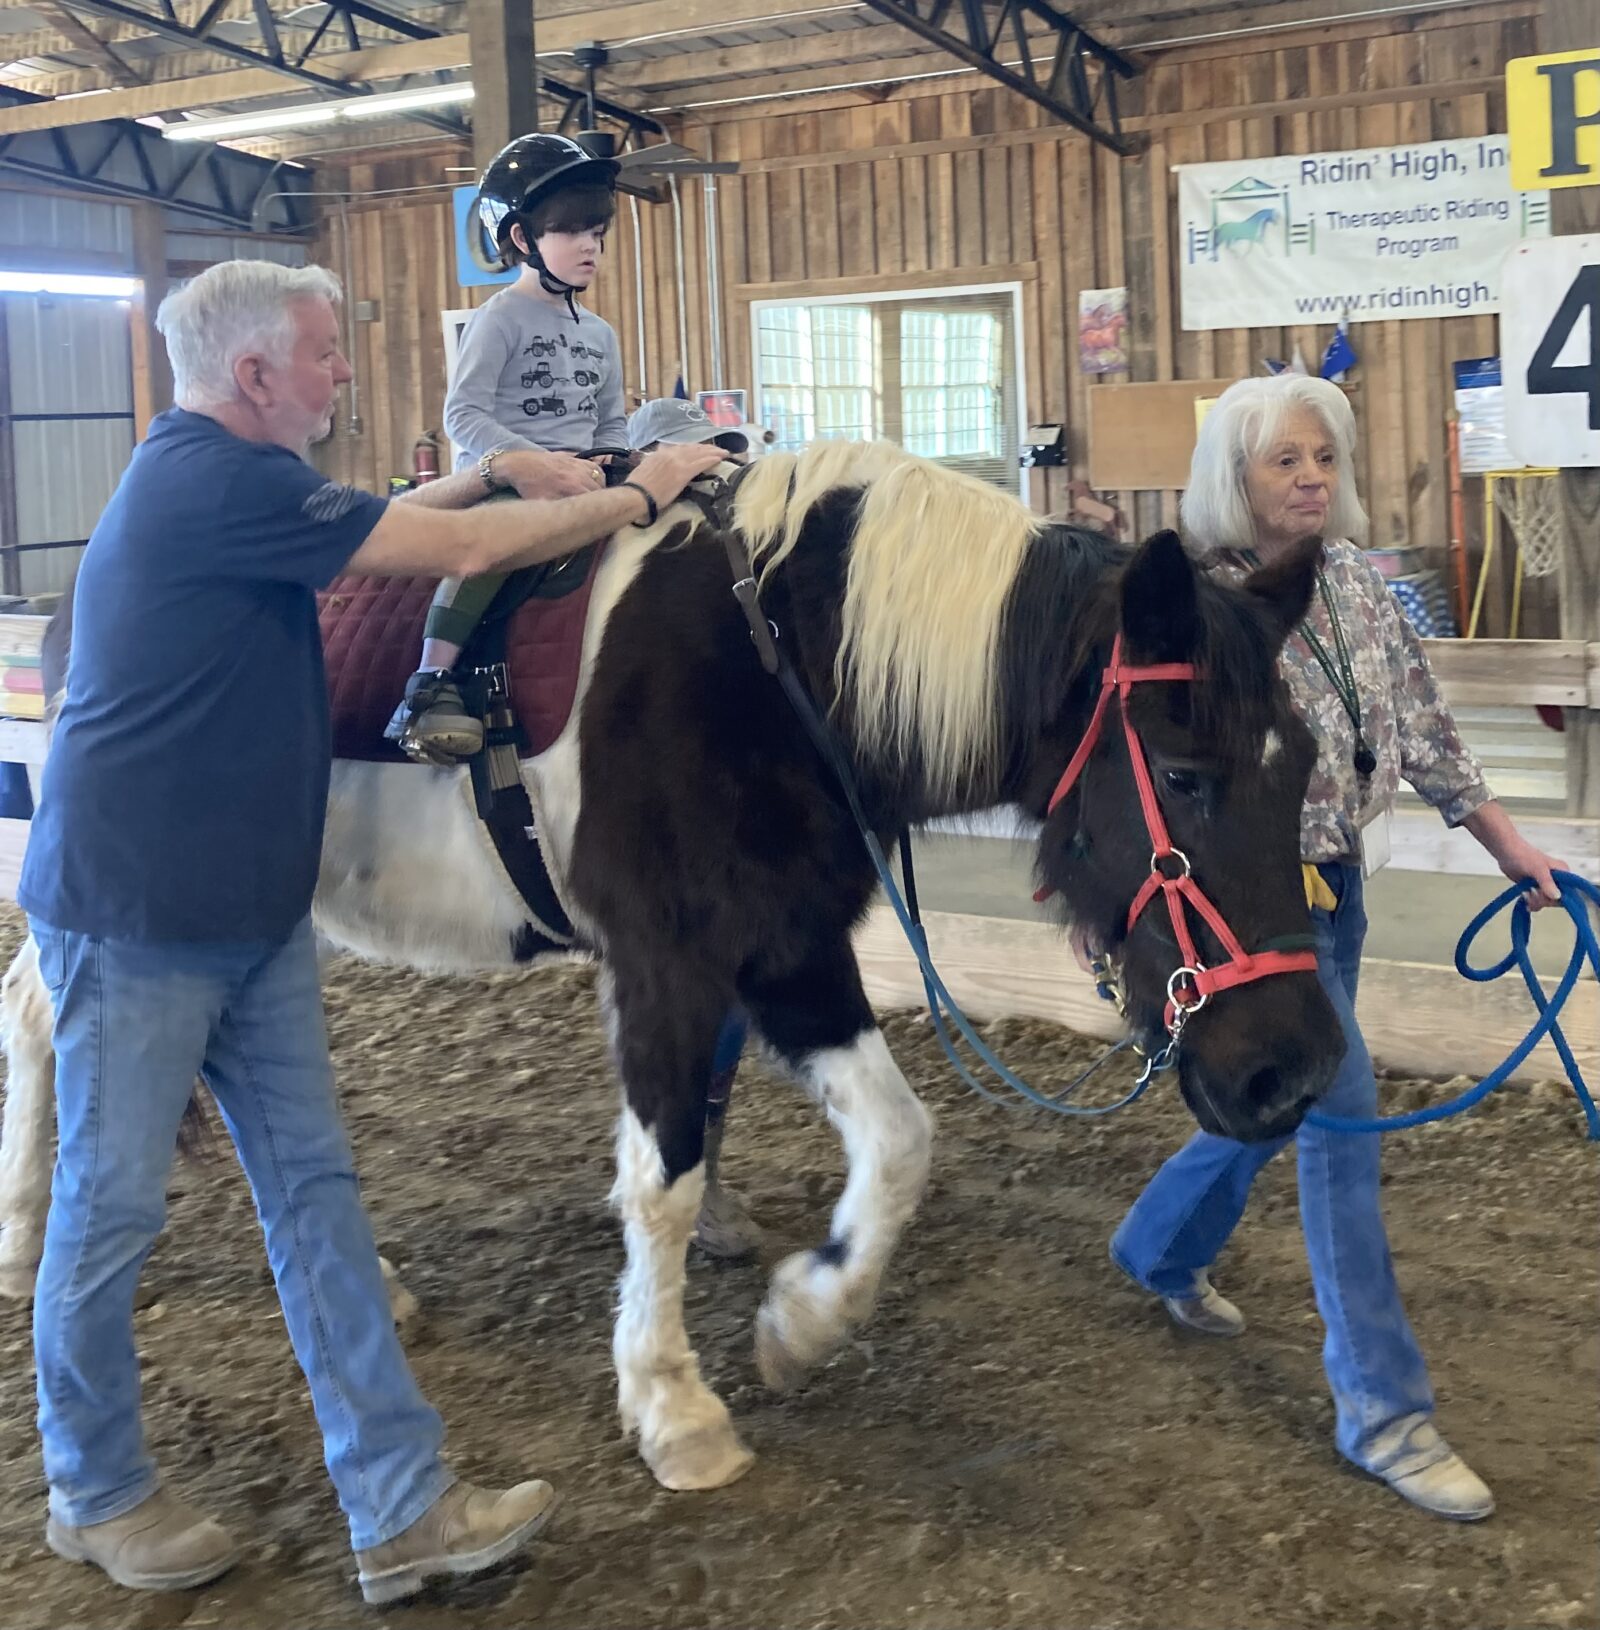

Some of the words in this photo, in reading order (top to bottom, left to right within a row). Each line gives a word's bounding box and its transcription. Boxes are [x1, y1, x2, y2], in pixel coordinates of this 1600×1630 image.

[1301, 154, 1380, 186] Ridin'
[1391, 147, 1467, 181] High,
[1478, 142, 1511, 169] In
[1326, 202, 1441, 231] Therapeutic
[1446, 197, 1509, 221] Riding
[1376, 235, 1460, 259] Program
[1296, 281, 1499, 313] www.ridinhigh.
[1526, 264, 1600, 431] 4
